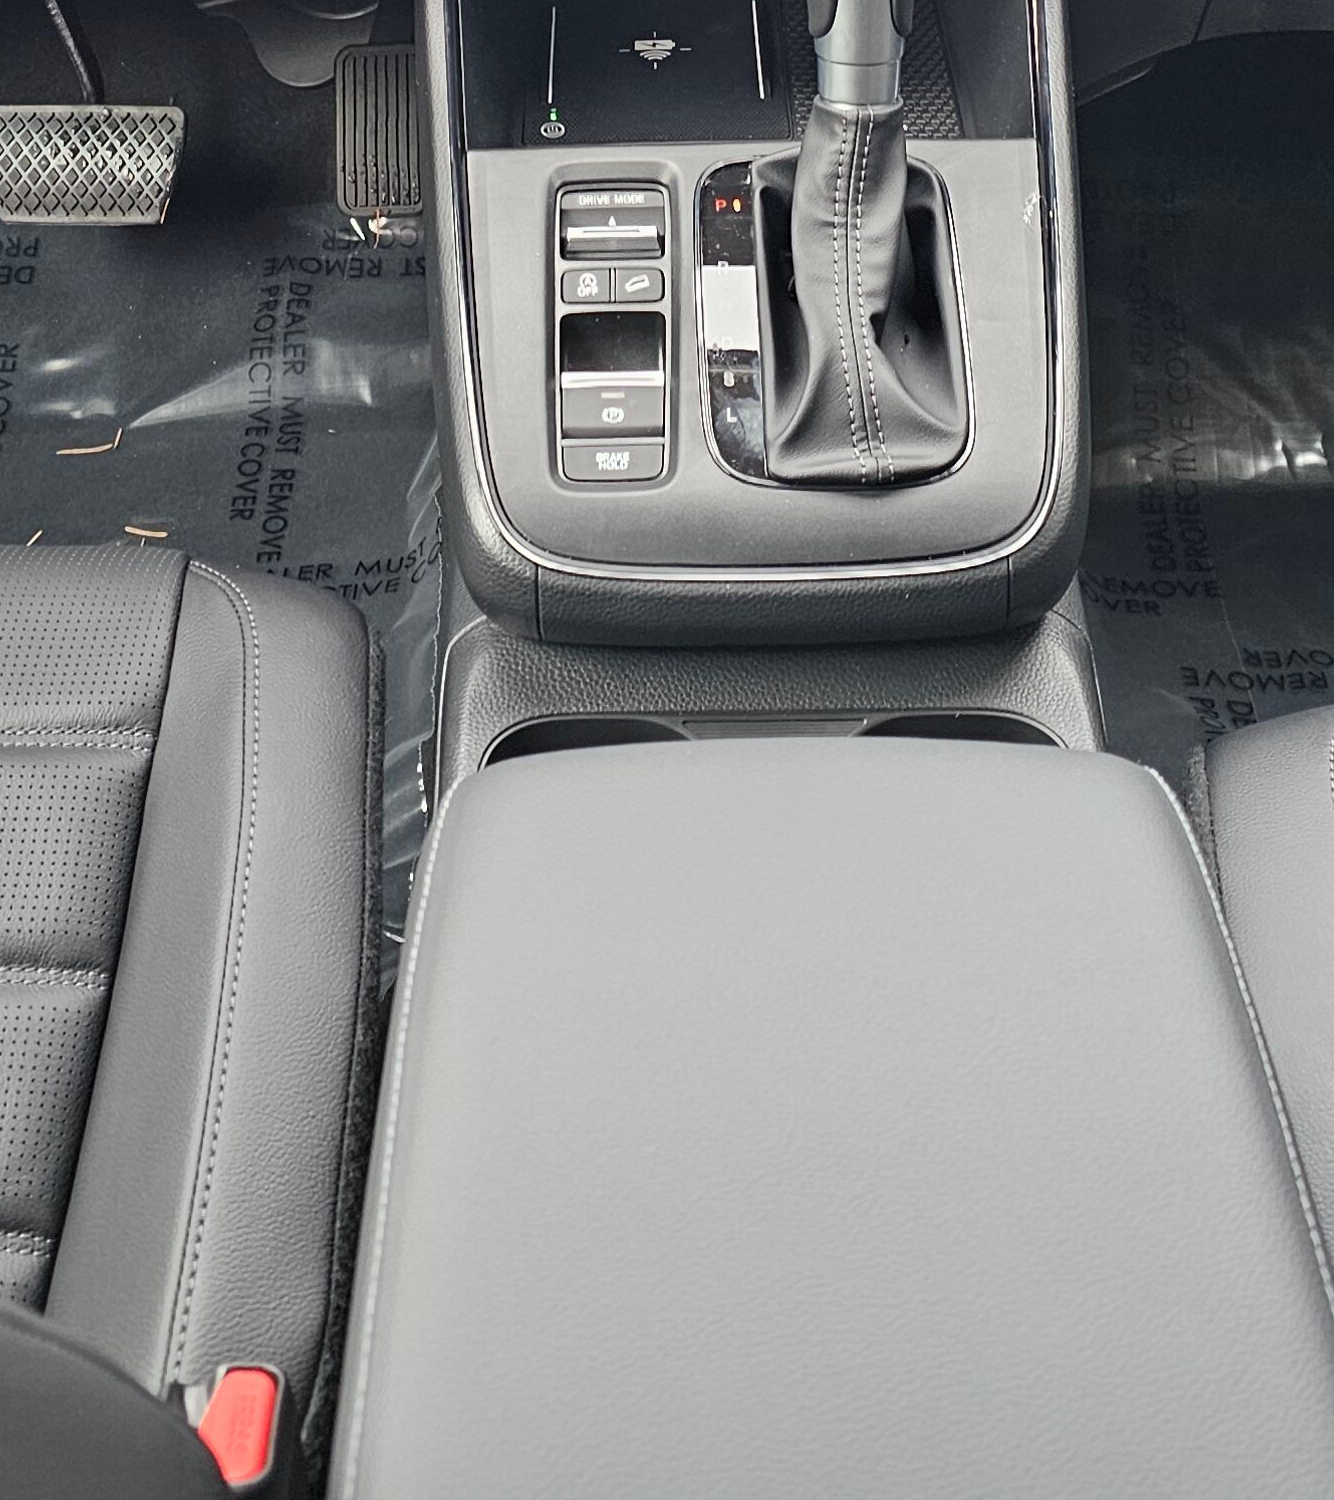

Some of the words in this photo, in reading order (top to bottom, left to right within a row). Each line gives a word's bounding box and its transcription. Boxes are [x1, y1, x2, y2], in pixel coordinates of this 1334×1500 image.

[579, 195, 610, 206] DRIVE
[614, 193, 646, 205] MODE
[716, 199, 727, 212] P
[263, 255, 383, 279] REMOVE
[286, 280, 313, 377] DEALER
[245, 285, 280, 439] PROTECTIVE
[273, 396, 310, 456] MUST
[726, 407, 738, 423] L
[596, 451, 631, 462] BRAKE
[598, 460, 629, 471] HOLD
[229, 439, 267, 522] COVER
[255, 466, 296, 565] REMOVE
[355, 536, 428, 577] MUST
[1179, 666, 1330, 693] REMOVE
